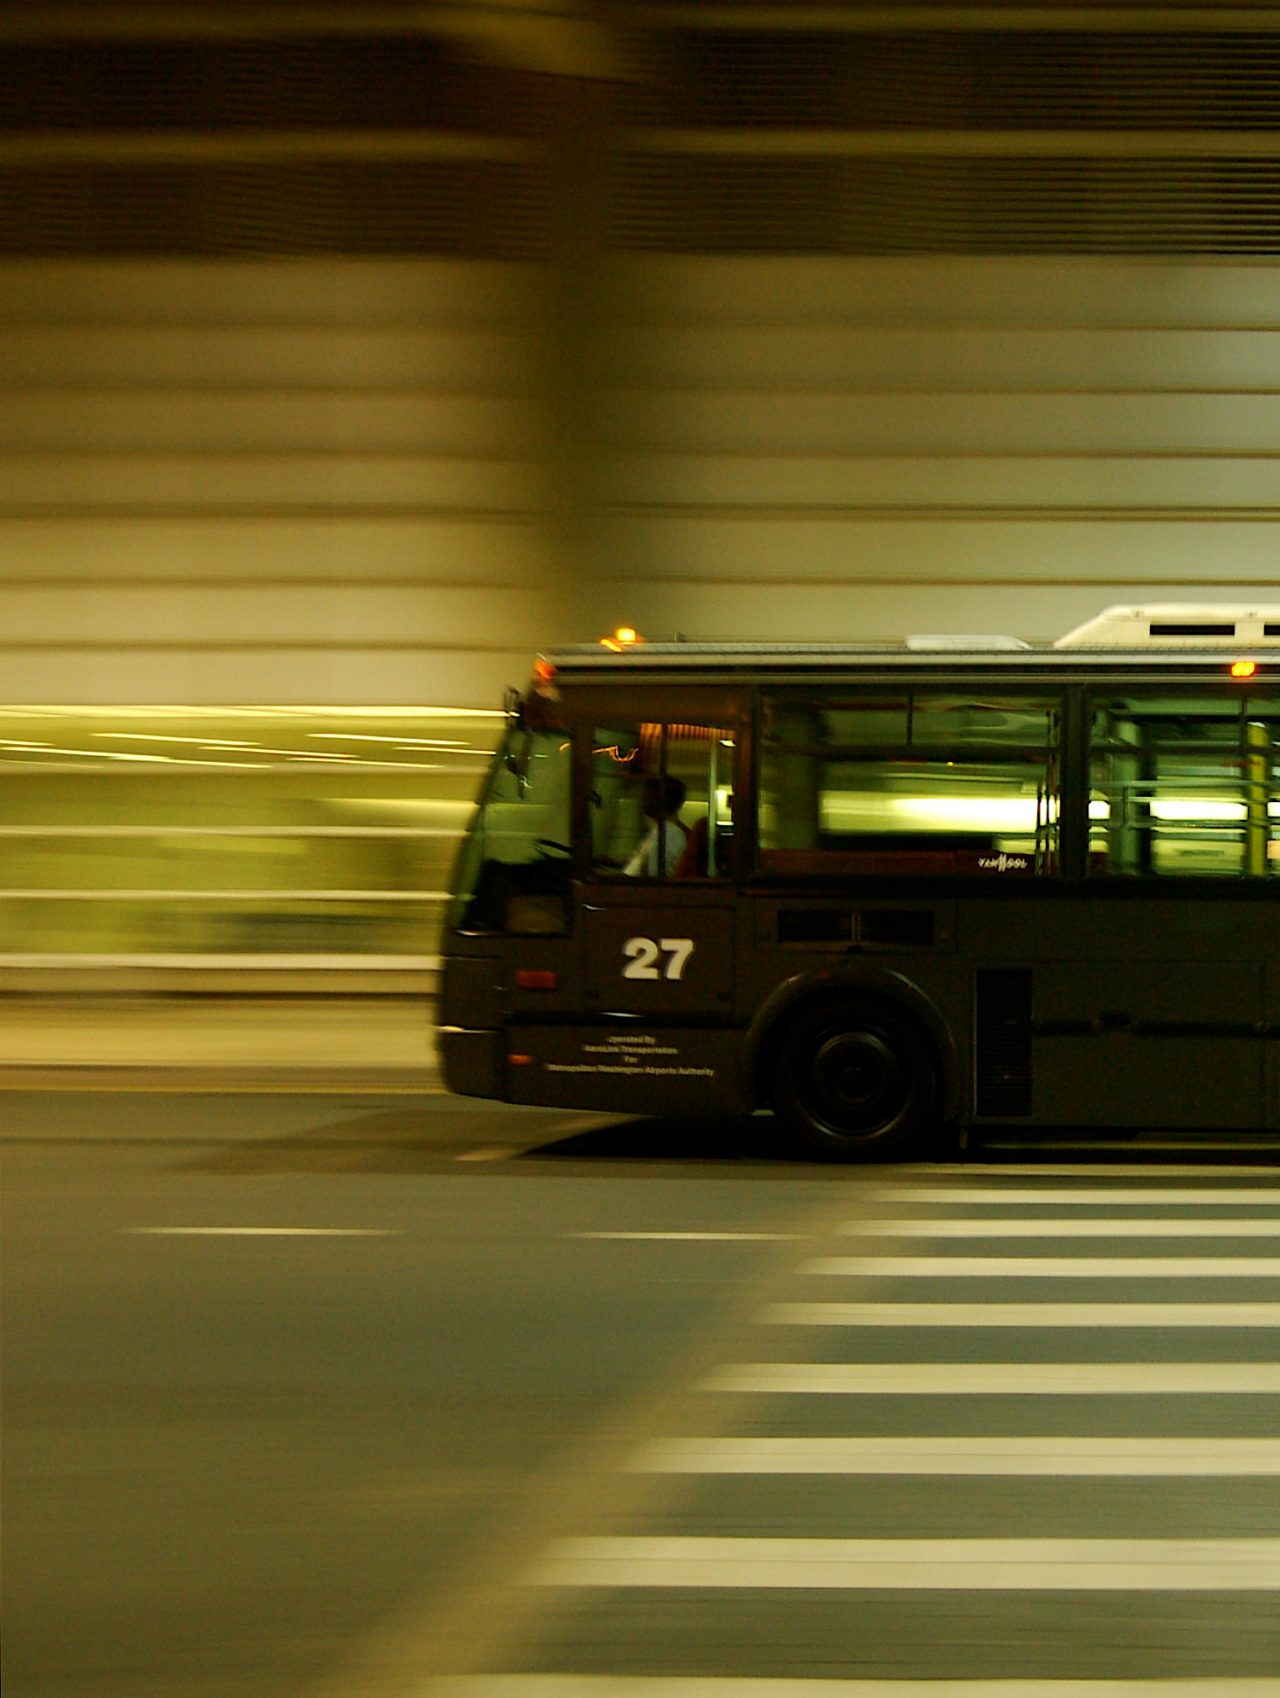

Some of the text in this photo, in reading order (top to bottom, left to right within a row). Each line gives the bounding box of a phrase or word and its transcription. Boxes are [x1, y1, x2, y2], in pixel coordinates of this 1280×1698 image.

[622, 936, 695, 980] 27
[645, 1065, 677, 1076] Airports
[678, 1066, 714, 1077] Authority
